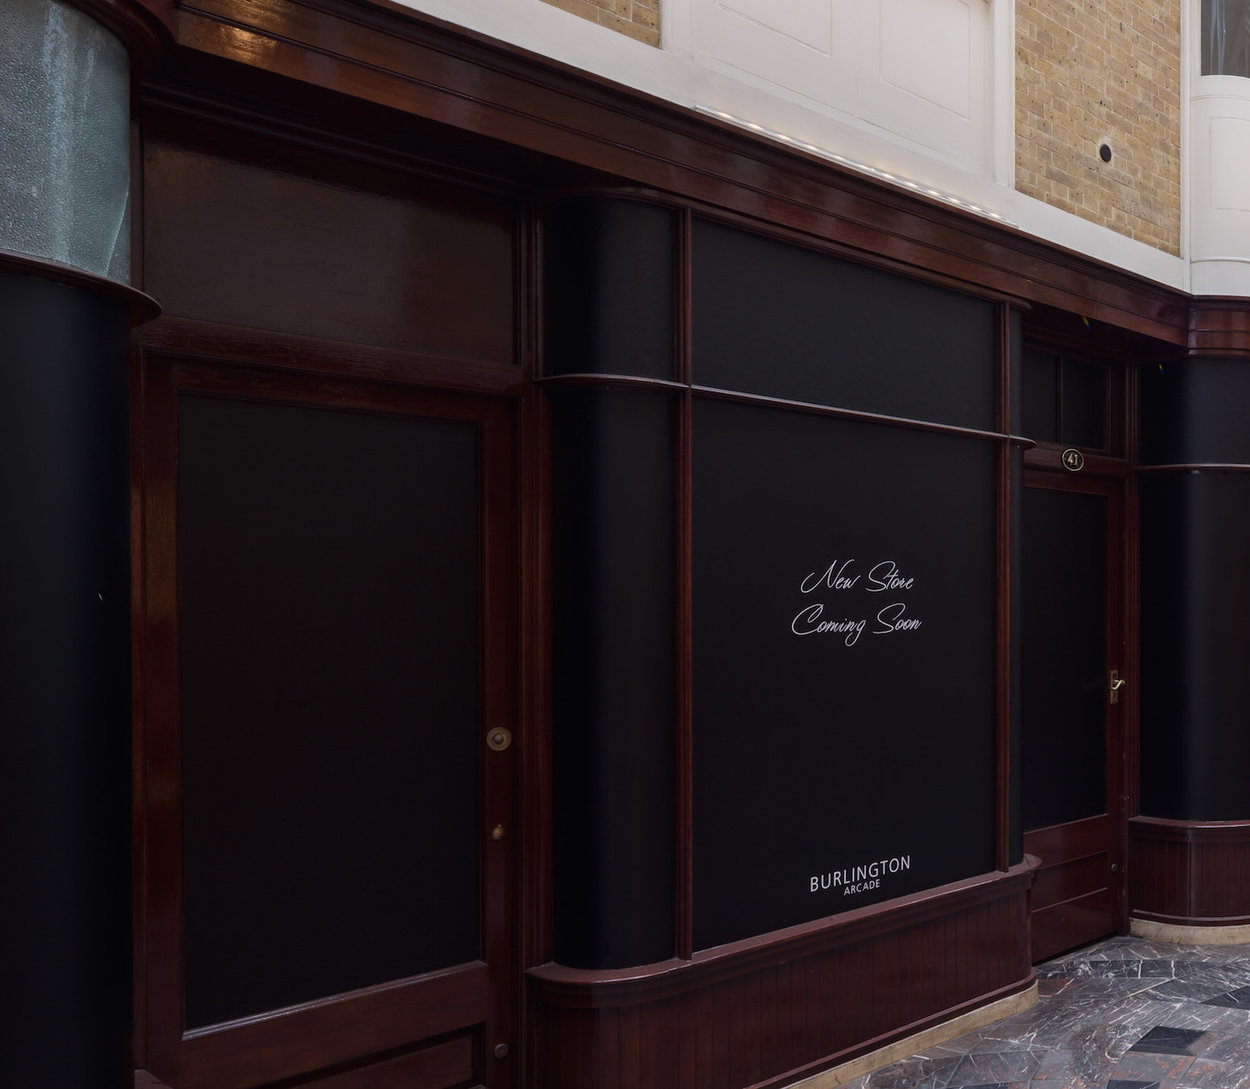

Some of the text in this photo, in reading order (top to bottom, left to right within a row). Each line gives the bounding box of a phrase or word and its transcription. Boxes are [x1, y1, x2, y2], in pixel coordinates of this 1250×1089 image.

[1067, 453, 1078, 466] 41
[800, 559, 914, 593] New Store
[791, 603, 922, 647] Coming Soon
[810, 855, 910, 892] BURLINGTON
[843, 879, 880, 896] ARCADE
